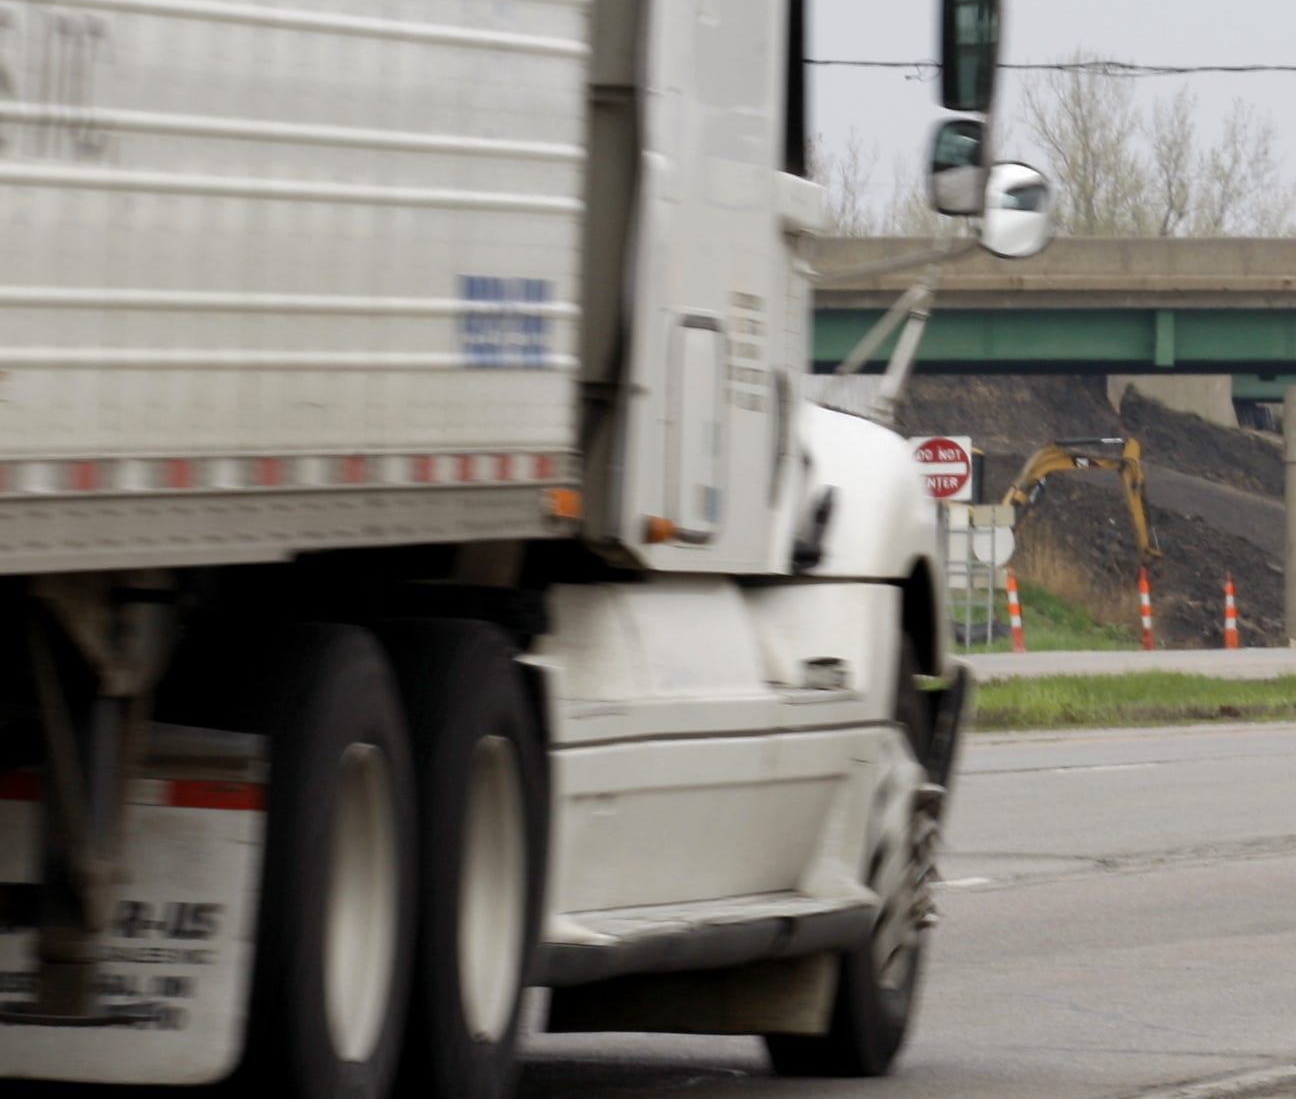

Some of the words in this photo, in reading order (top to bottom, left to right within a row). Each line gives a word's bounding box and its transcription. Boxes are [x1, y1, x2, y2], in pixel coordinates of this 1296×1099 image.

[916, 448, 934, 462] DO
[938, 447, 961, 461] NOT
[927, 476, 959, 489] NTER
